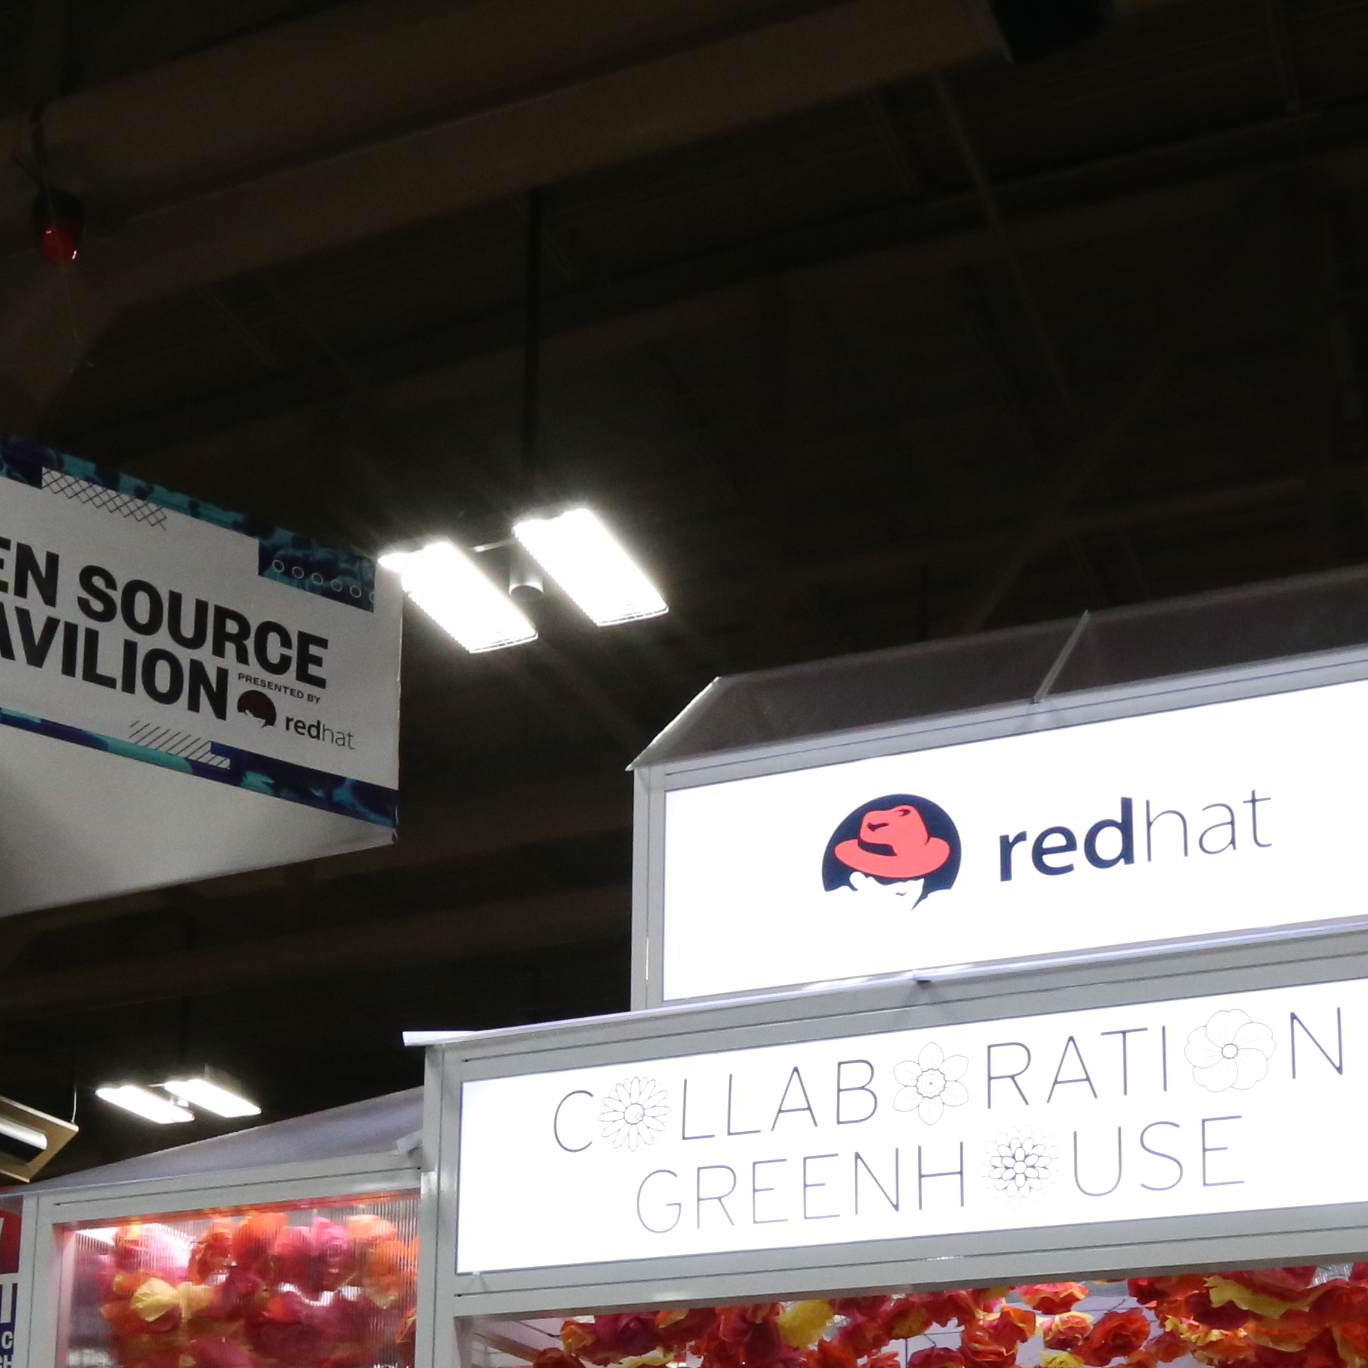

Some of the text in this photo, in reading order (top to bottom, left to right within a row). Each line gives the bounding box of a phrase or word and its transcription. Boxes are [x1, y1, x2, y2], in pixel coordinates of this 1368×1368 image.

[77, 565, 329, 689] SOURCE
[238, 672, 321, 704] PRESENTED BY
[285, 716, 356, 750] redhat
[999, 788, 1272, 883] redhat
